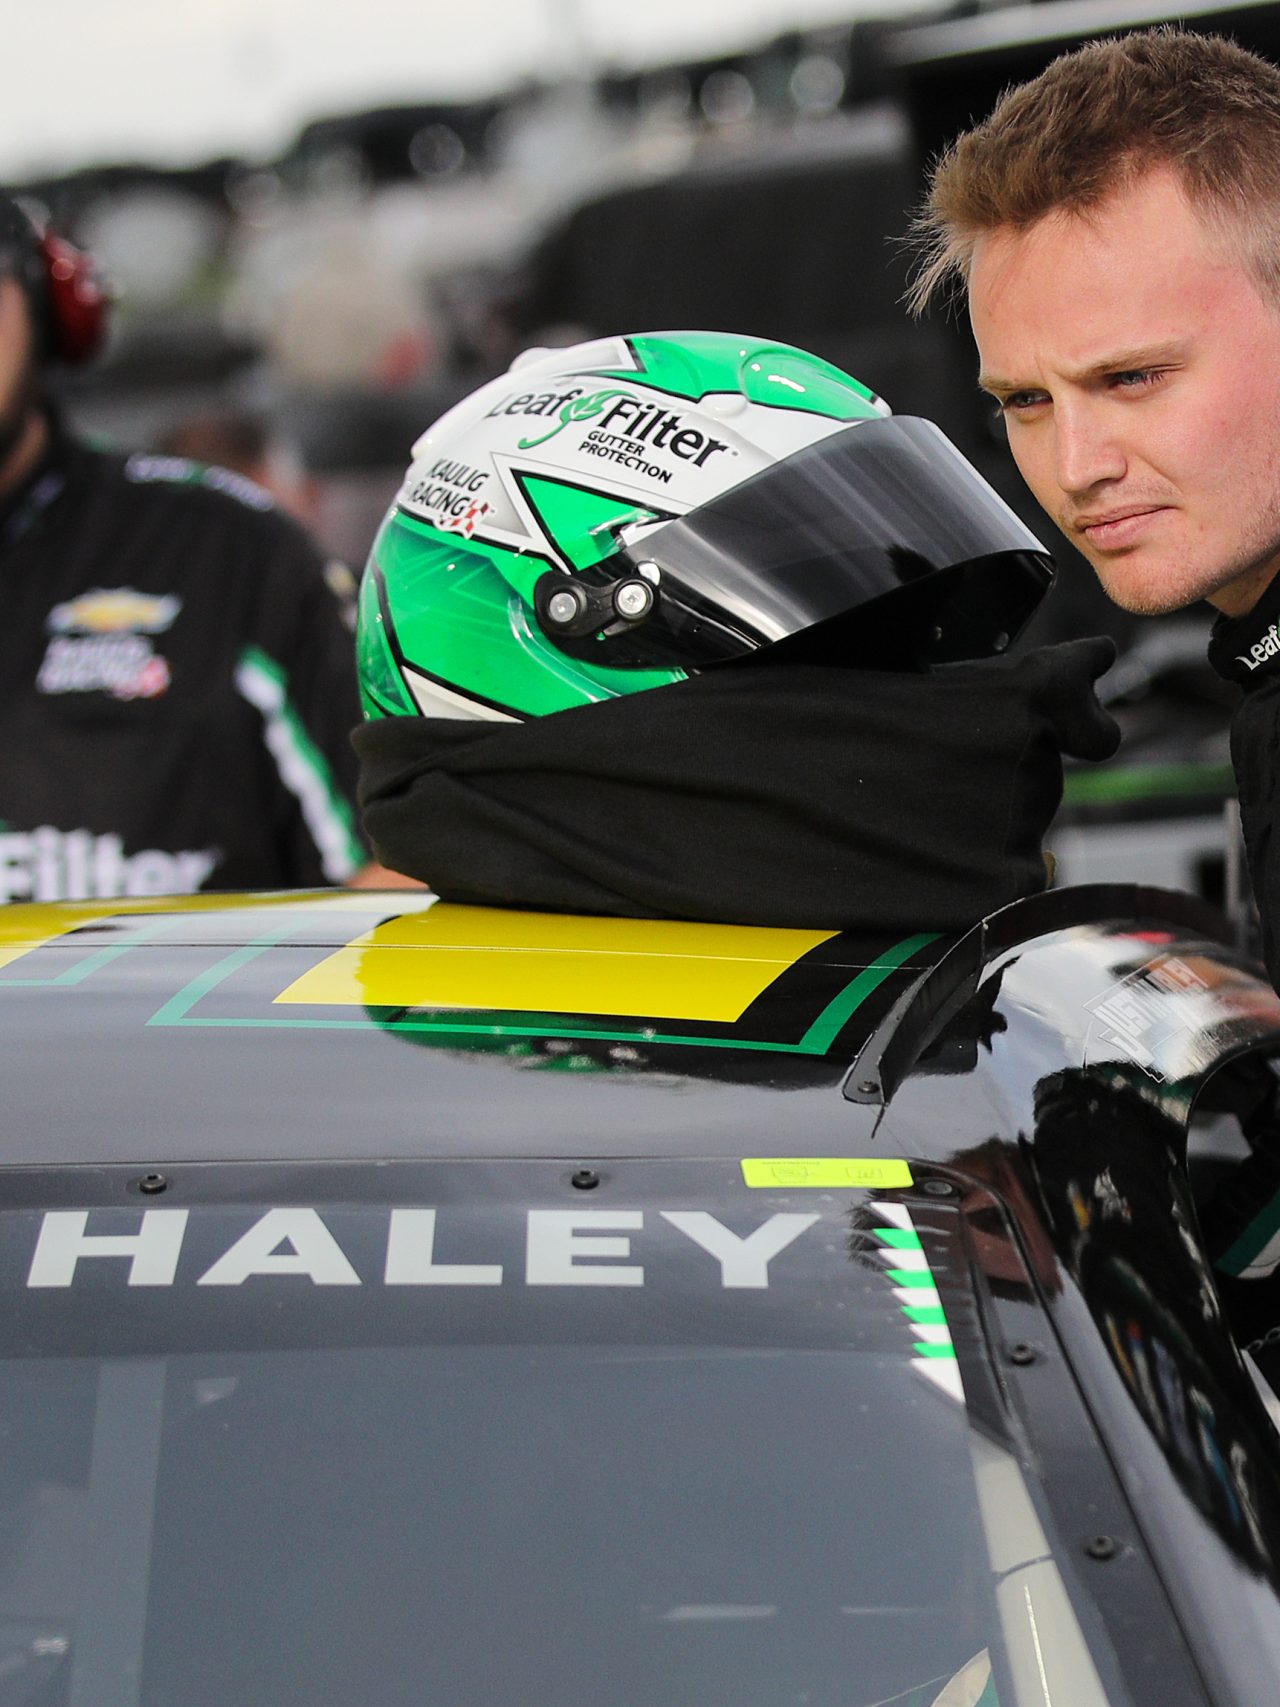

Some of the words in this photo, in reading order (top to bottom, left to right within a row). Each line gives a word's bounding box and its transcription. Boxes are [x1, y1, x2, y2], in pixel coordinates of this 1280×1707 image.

[484, 388, 583, 420] Leaf
[596, 398, 729, 468] Filter
[587, 430, 645, 457] GUTTER
[427, 458, 490, 492] KAULIG
[579, 441, 672, 484] PROTECTION
[411, 481, 472, 517] RACING
[26, 1208, 823, 1289] HALEY
